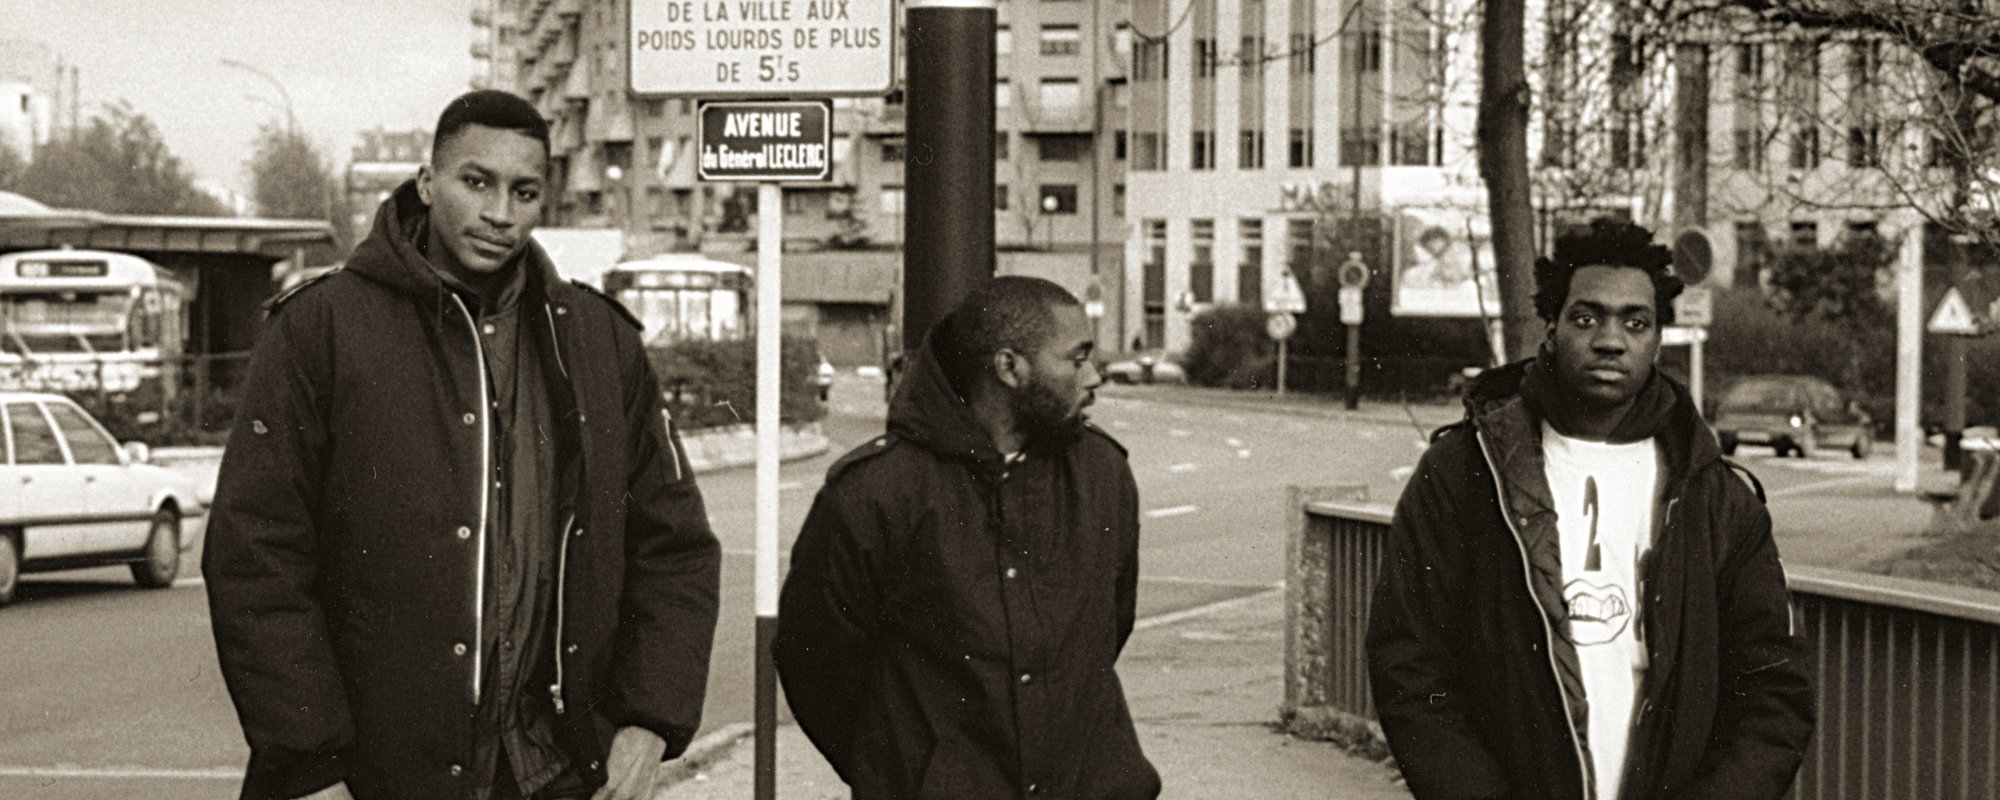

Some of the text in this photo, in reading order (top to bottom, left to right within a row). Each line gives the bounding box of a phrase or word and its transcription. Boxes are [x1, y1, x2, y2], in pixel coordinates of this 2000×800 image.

[667, 0, 849, 22] DE LA VILLE AUX
[638, 27, 881, 51] POIDS LOURDS DE PLUS
[716, 61, 741, 83] DE
[723, 112, 802, 138] AVENUE
[703, 143, 718, 169] du
[769, 143, 824, 169] LECLERC
